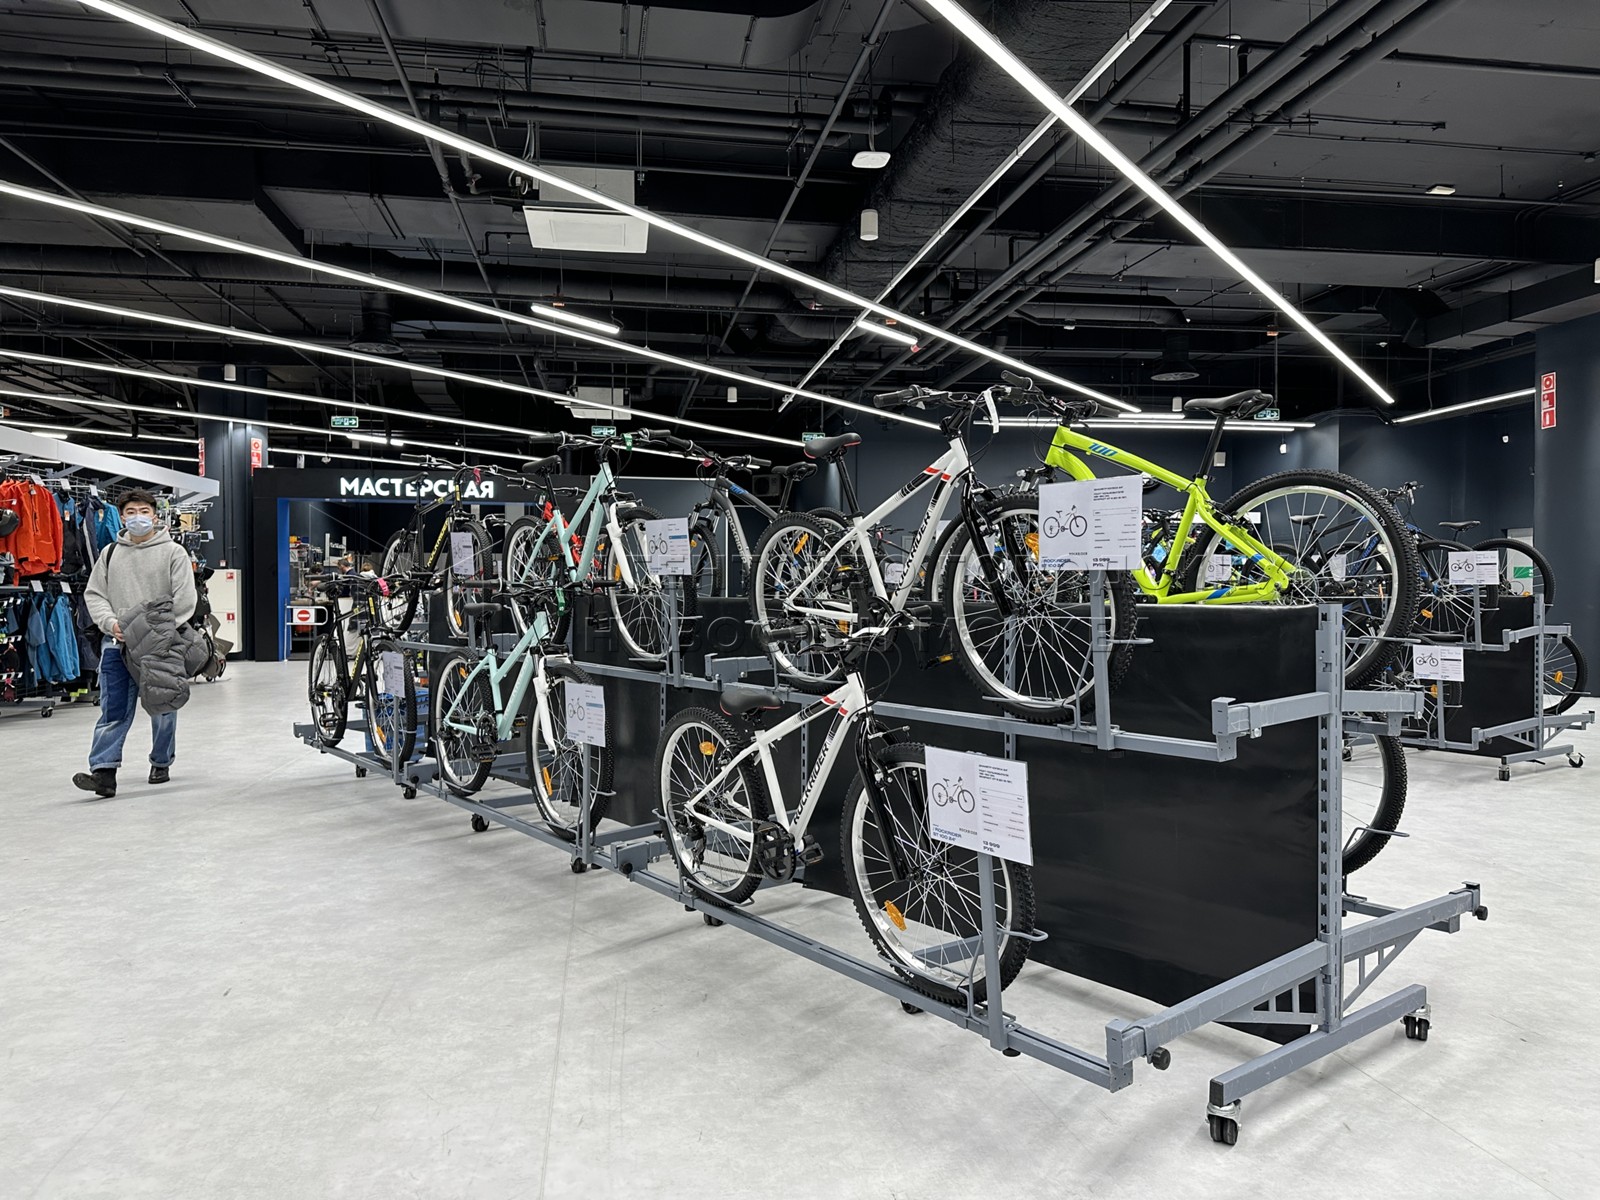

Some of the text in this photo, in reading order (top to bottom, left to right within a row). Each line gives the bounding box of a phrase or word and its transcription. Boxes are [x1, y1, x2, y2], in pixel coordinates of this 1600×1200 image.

[1088, 442, 1118, 456] 100
[726, 509, 748, 564] ROCKRIDER
[894, 511, 931, 597] ROCKRIDER
[794, 742, 830, 825] ROCKRIDER
